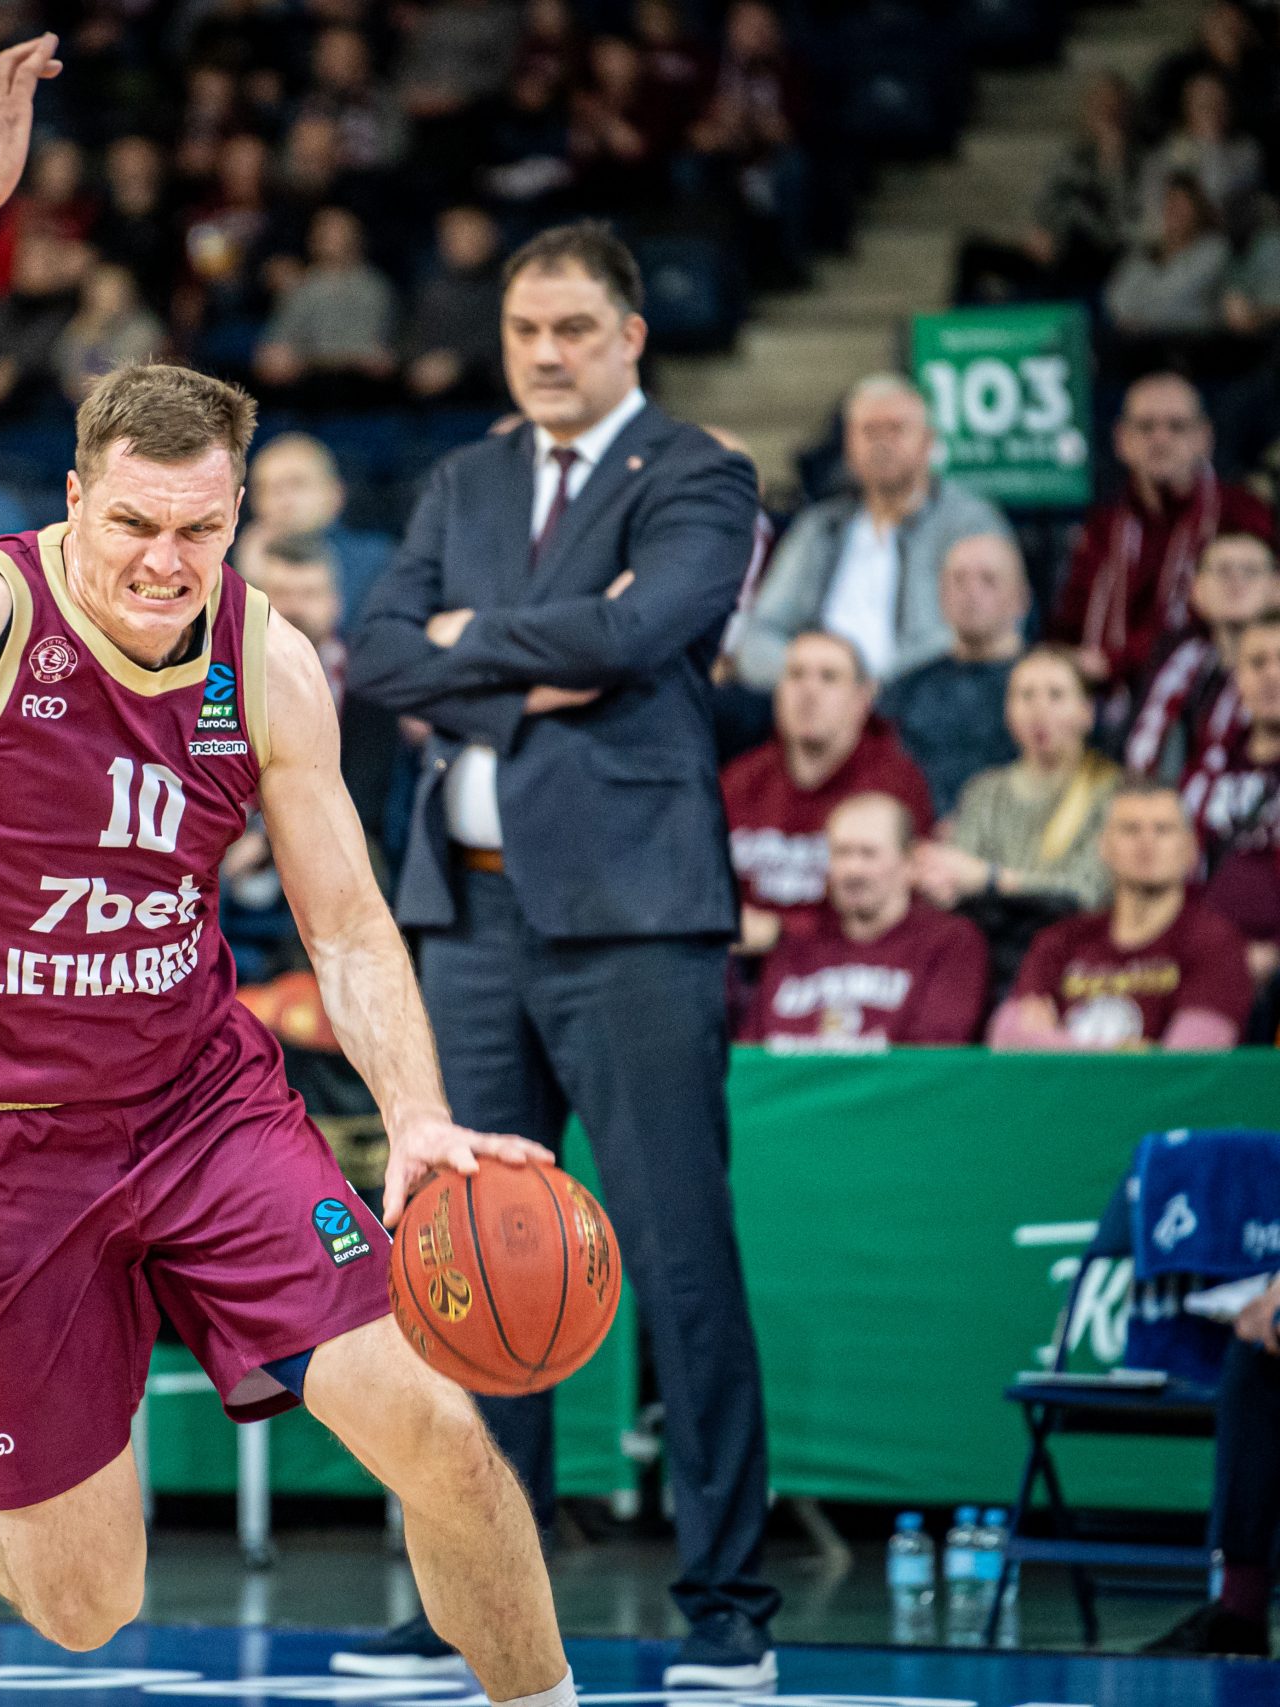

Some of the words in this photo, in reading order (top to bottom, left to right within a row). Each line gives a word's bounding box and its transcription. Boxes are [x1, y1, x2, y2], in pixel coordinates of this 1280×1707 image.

[923, 354, 1073, 436] 103
[202, 705, 232, 717] BKT
[197, 719, 238, 729] EuroCup
[189, 741, 247, 754] oneteam
[98, 756, 186, 853] 10
[29, 874, 202, 934] 7bet
[334, 1243, 370, 1263] EuroCup
